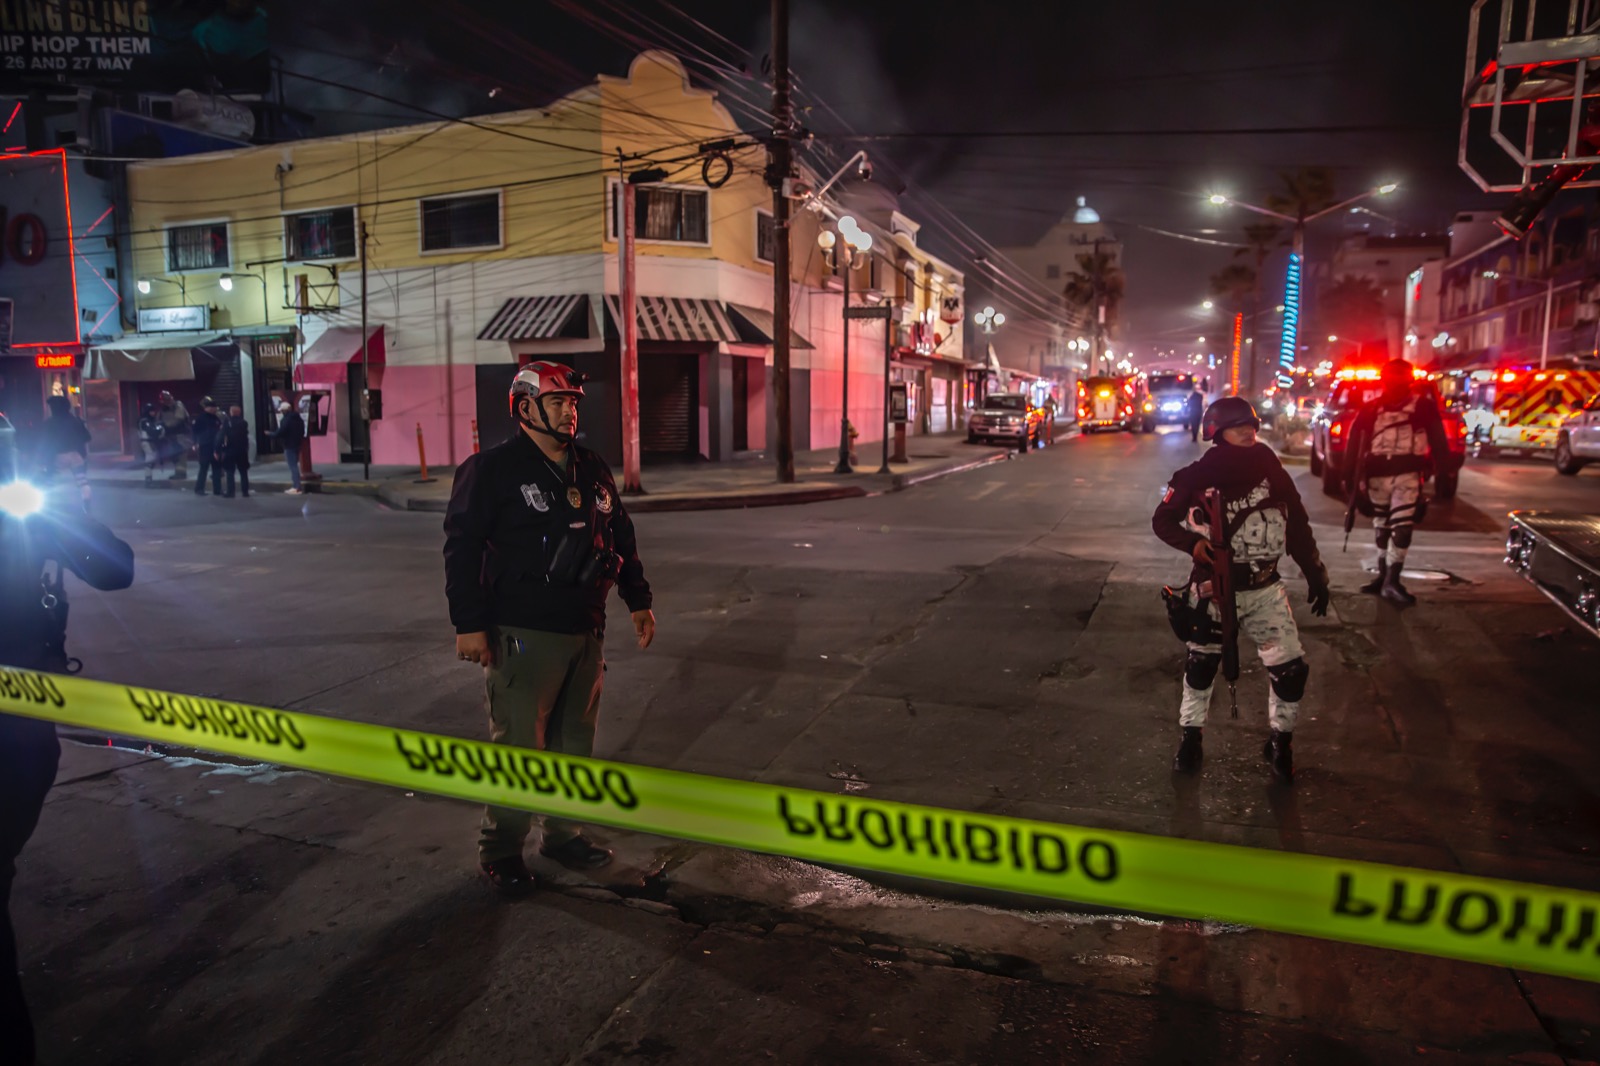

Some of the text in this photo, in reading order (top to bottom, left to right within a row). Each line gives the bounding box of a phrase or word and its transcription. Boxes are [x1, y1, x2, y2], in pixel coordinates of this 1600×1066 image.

[31, 36, 80, 54] HOP
[86, 36, 152, 55] THEM
[5, 56, 134, 71] 26 AND 27 MAY
